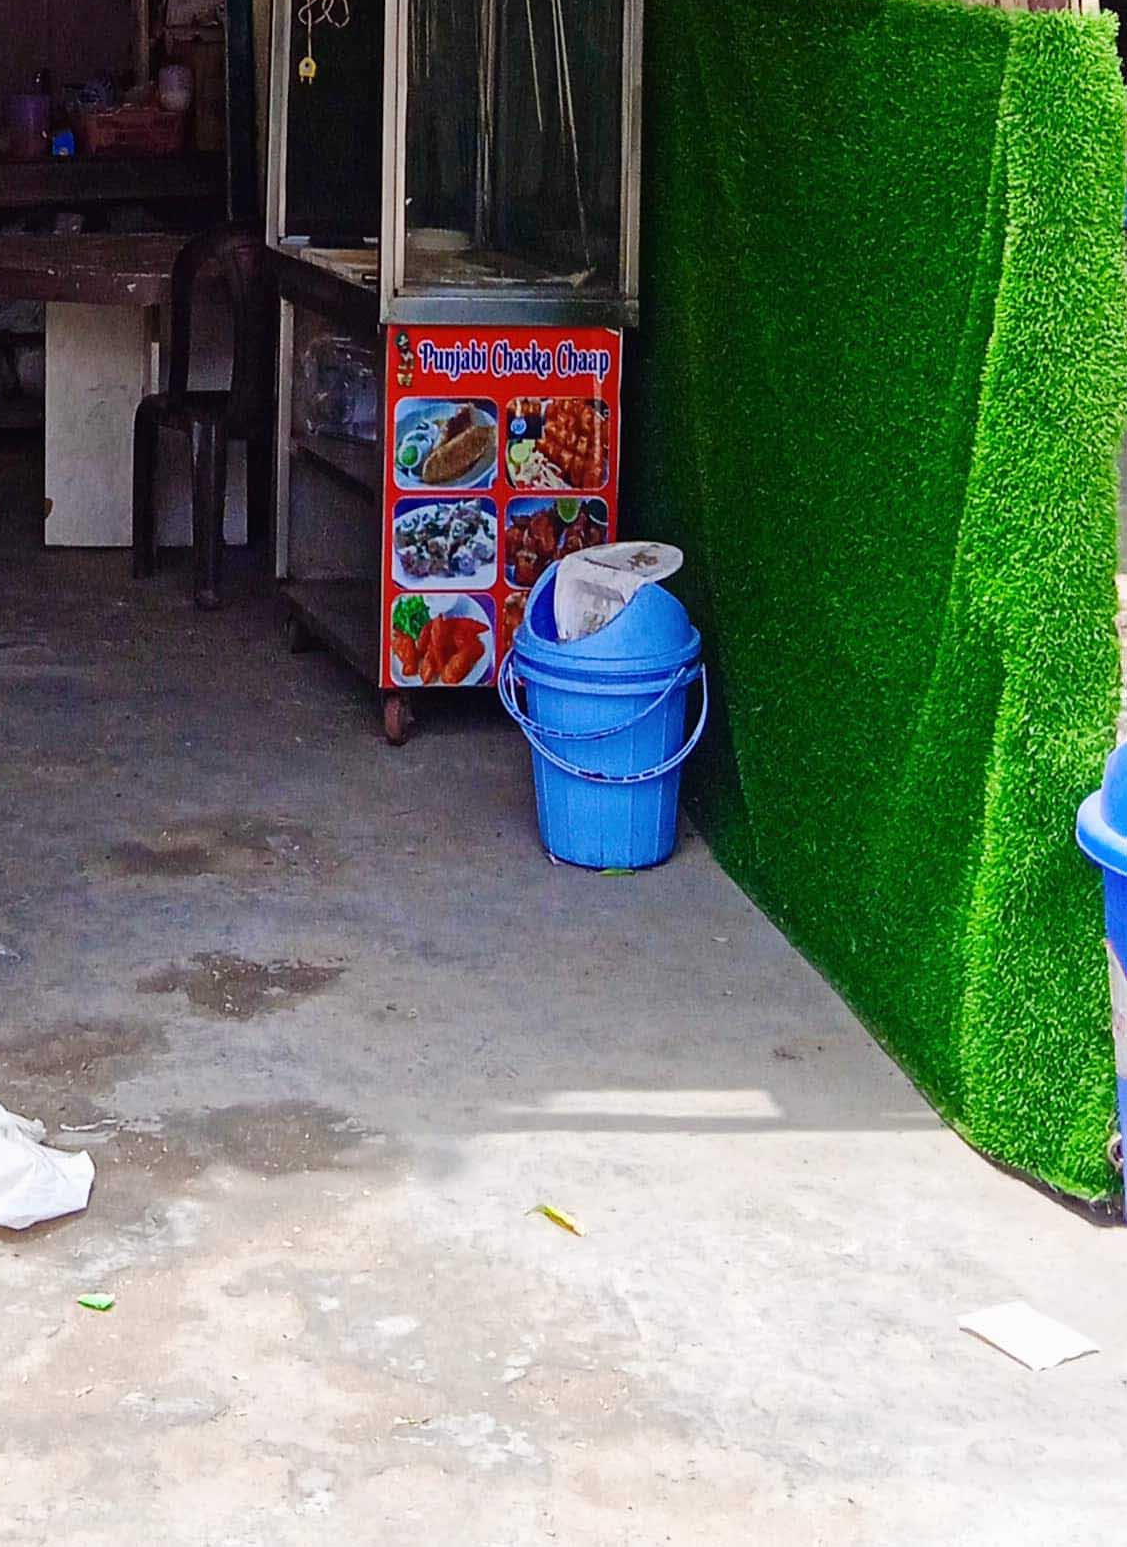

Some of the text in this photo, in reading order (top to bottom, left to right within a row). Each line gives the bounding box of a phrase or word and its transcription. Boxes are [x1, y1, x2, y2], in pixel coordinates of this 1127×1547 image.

[418, 339, 610, 382] Punjabi Chaska Chaap
